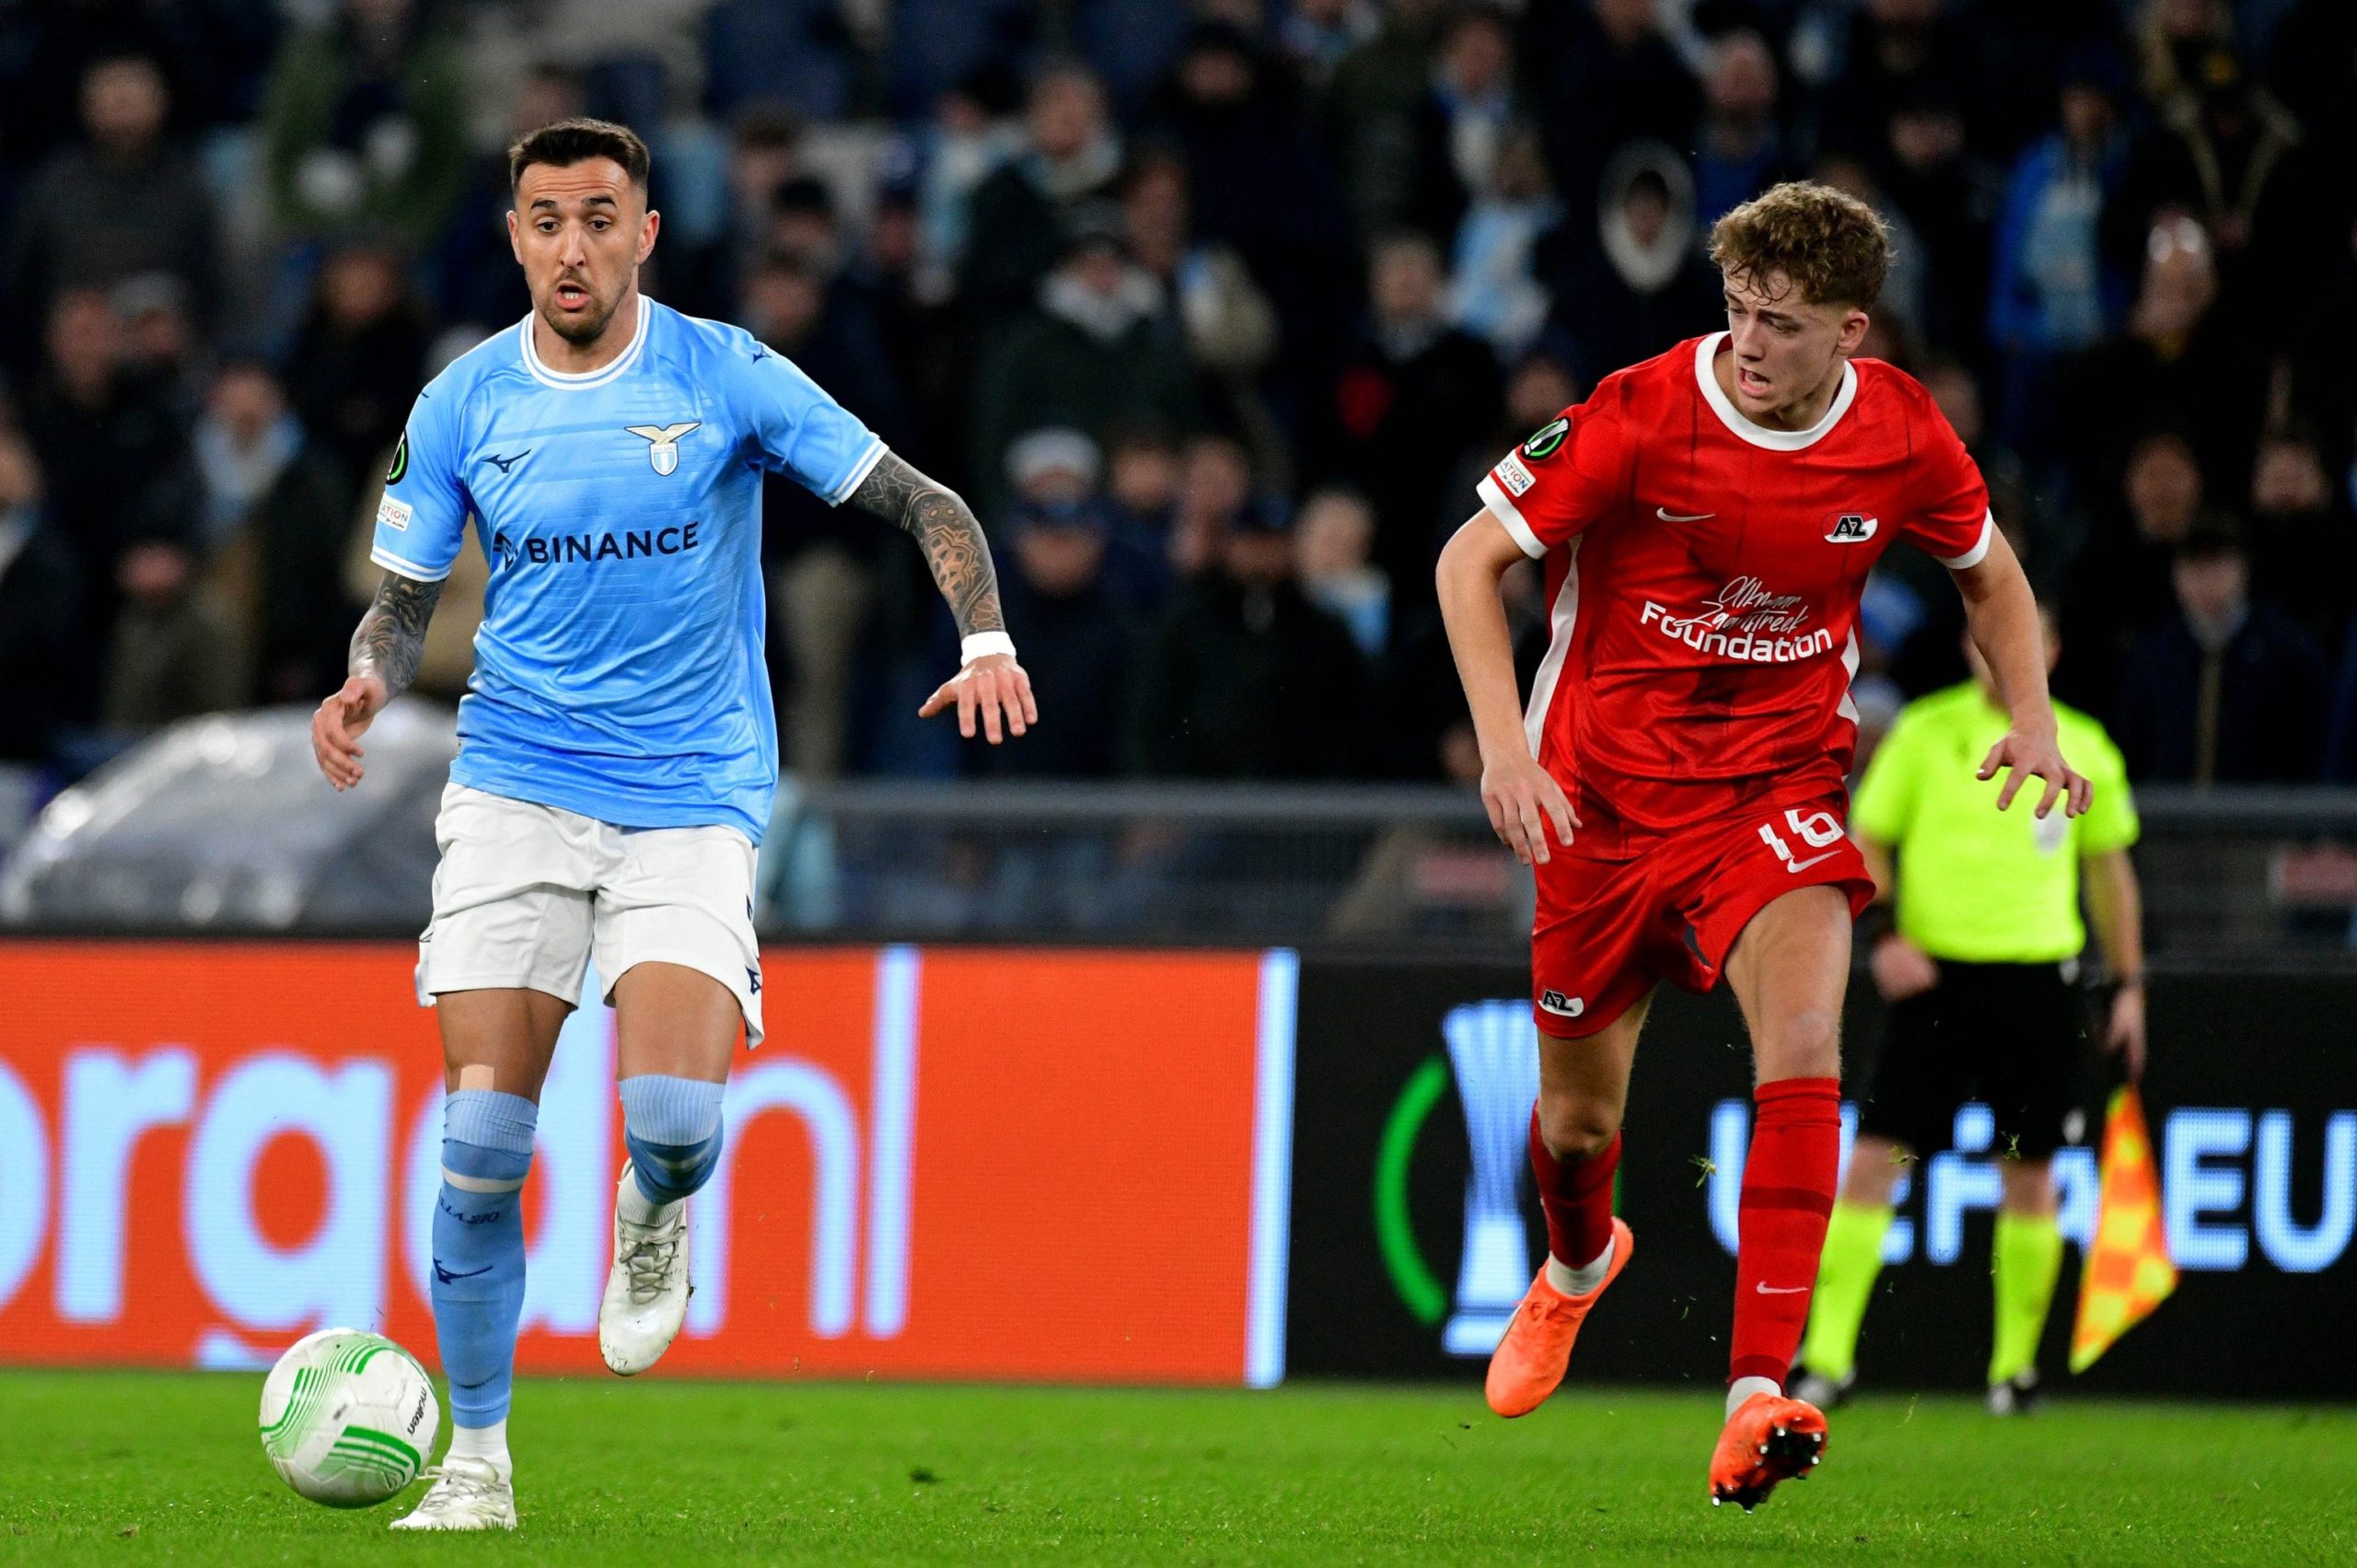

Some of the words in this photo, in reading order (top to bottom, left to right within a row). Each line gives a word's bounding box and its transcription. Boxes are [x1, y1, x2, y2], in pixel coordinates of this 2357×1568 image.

[525, 521, 698, 563] BINANCE
[1831, 516, 1868, 539] AZ
[1640, 600, 1833, 662] Foundation
[1757, 807, 1845, 862] 16
[1542, 990, 1575, 1013] AZ
[2162, 1106, 2357, 1272] EU
[407, 1386, 427, 1436] molten
